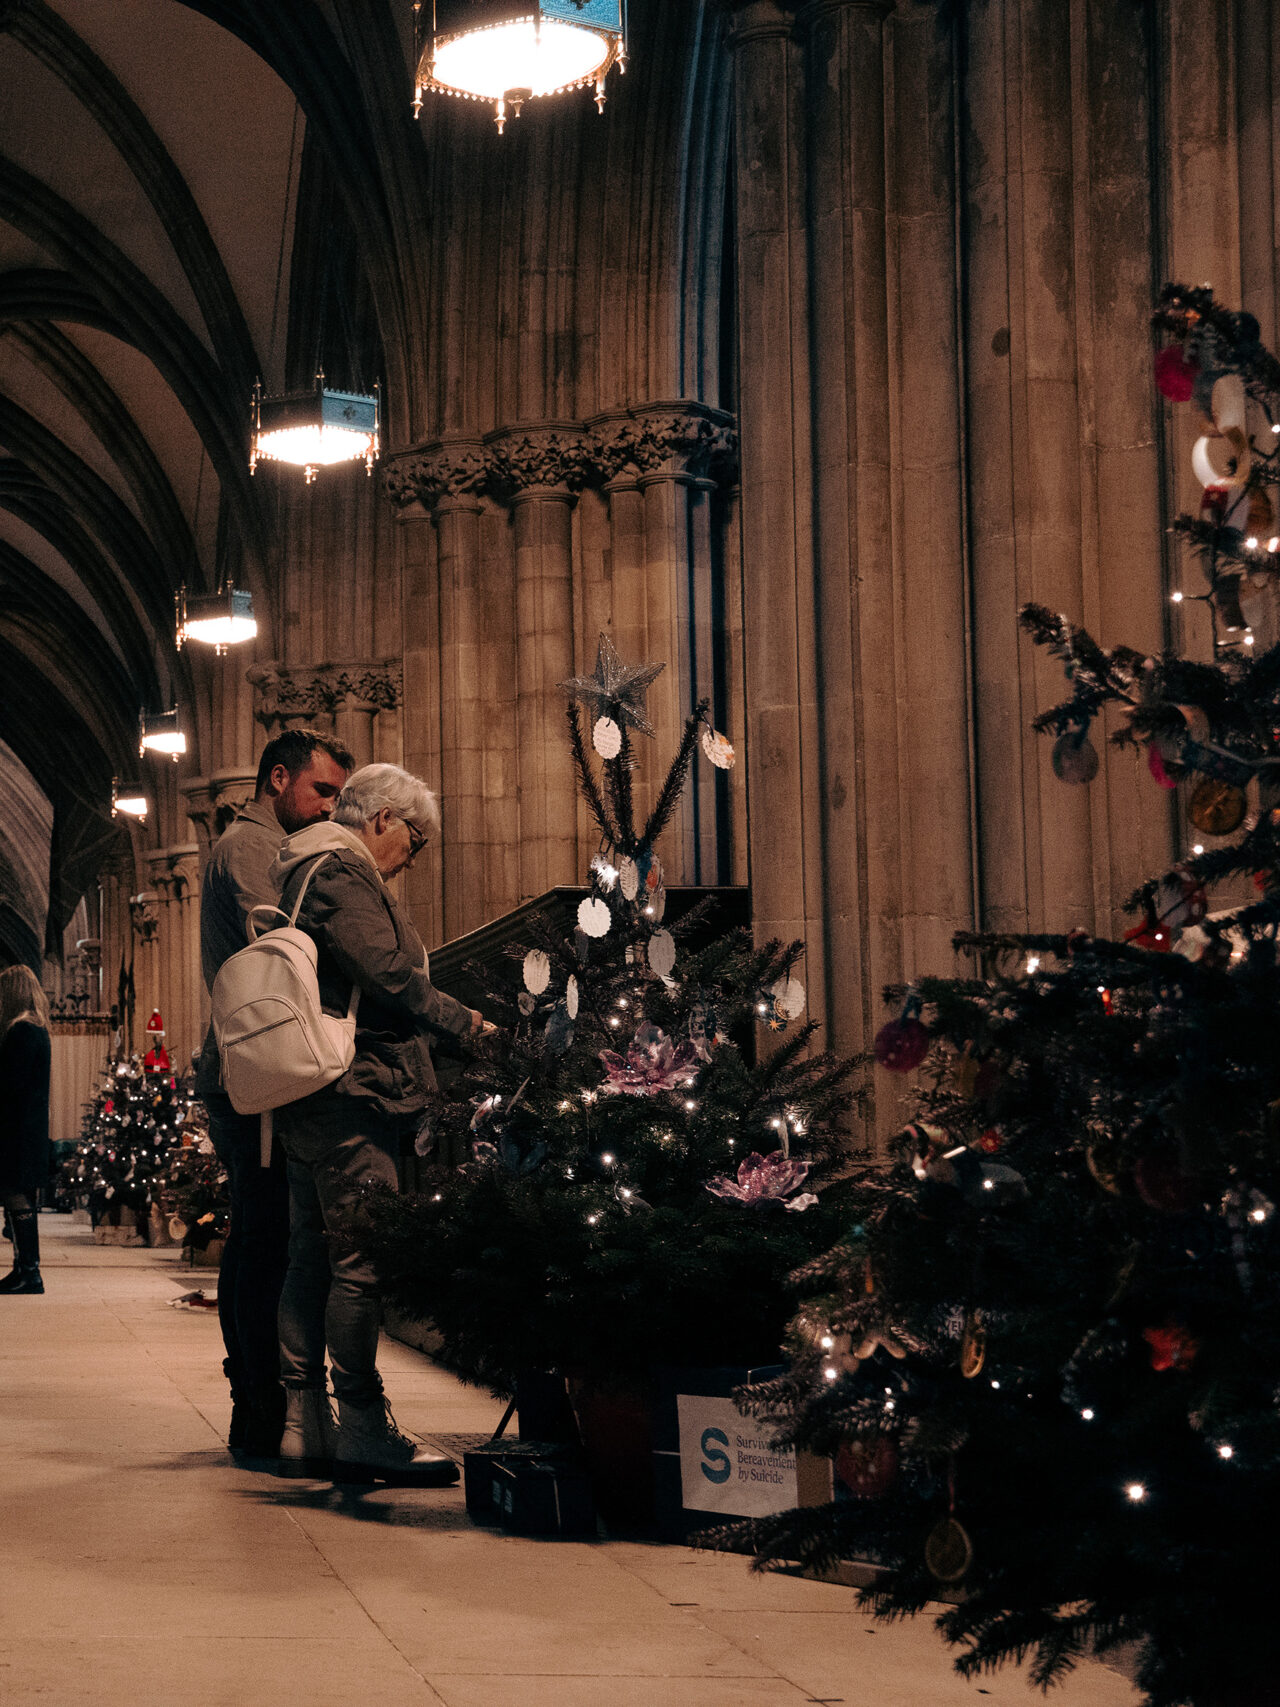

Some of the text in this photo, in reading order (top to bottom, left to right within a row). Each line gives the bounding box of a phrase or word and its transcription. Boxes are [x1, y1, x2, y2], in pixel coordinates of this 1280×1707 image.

[737, 1450, 797, 1470] Bereavement
[738, 1467, 784, 1485] by Suicide
